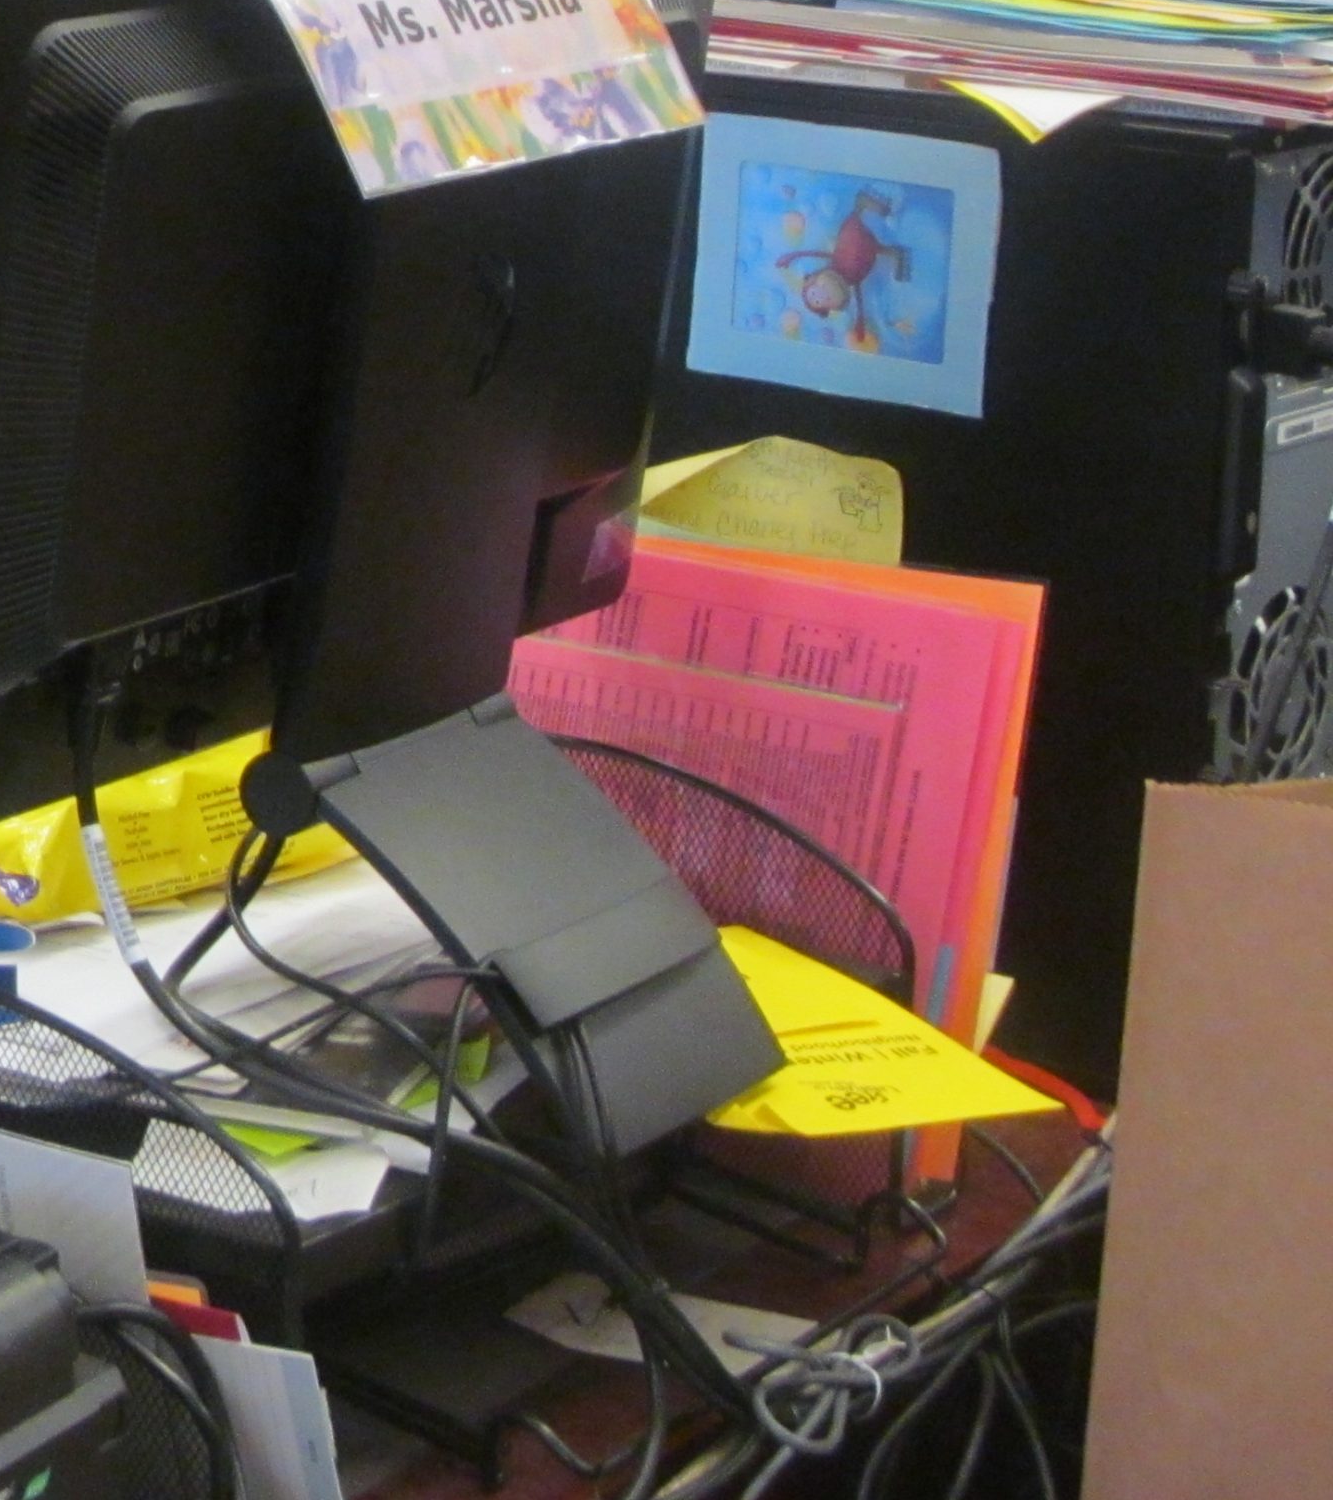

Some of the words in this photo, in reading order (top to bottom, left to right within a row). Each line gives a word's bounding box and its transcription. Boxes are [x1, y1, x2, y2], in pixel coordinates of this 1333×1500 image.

[358, 0, 438, 50] Ms.
[790, 1033, 922, 1054] Neighborhood
[885, 1044, 938, 1064] Fall
